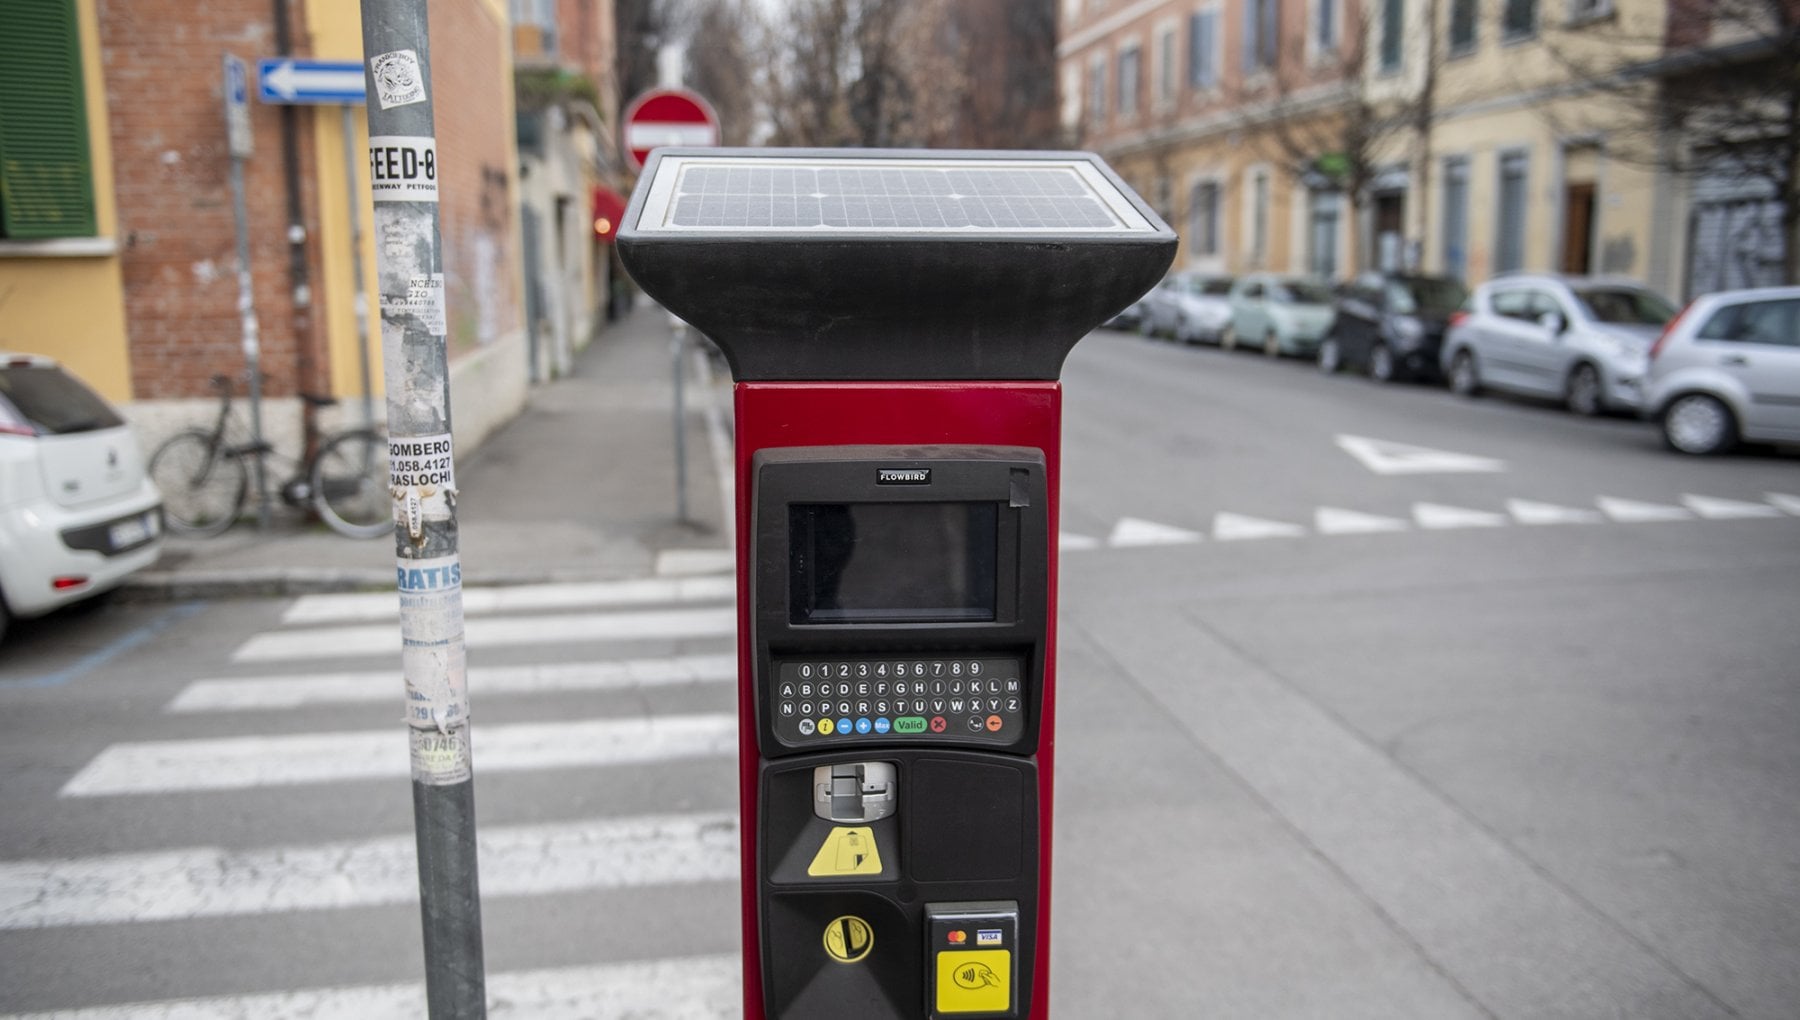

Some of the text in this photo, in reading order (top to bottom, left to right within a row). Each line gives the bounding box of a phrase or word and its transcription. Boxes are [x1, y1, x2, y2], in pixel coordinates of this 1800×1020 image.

[880, 473, 926, 481] FLOWBIRD
[803, 666, 810, 676] 0
[841, 665, 848, 675] 2
[860, 665, 867, 675] 3
[878, 665, 885, 675] 4
[897, 664, 904, 675] 5
[916, 664, 923, 674] 6
[935, 664, 942, 674] 7
[953, 663, 960, 674] 8
[972, 663, 979, 674] 9
[784, 686, 792, 694] A
[803, 685, 810, 694] B
[822, 685, 829, 694] C
[841, 685, 848, 694] D
[860, 684, 867, 693] E
[879, 684, 886, 693] F
[896, 684, 905, 693] G
[916, 683, 923, 692] H
[953, 683, 960, 692] J
[972, 682, 979, 691] K
[991, 682, 998, 691] L
[1008, 682, 1017, 690] M
[784, 700, 1016, 713] N O P Q R S T U V W X Y Z
[899, 720, 923, 729] Valid
